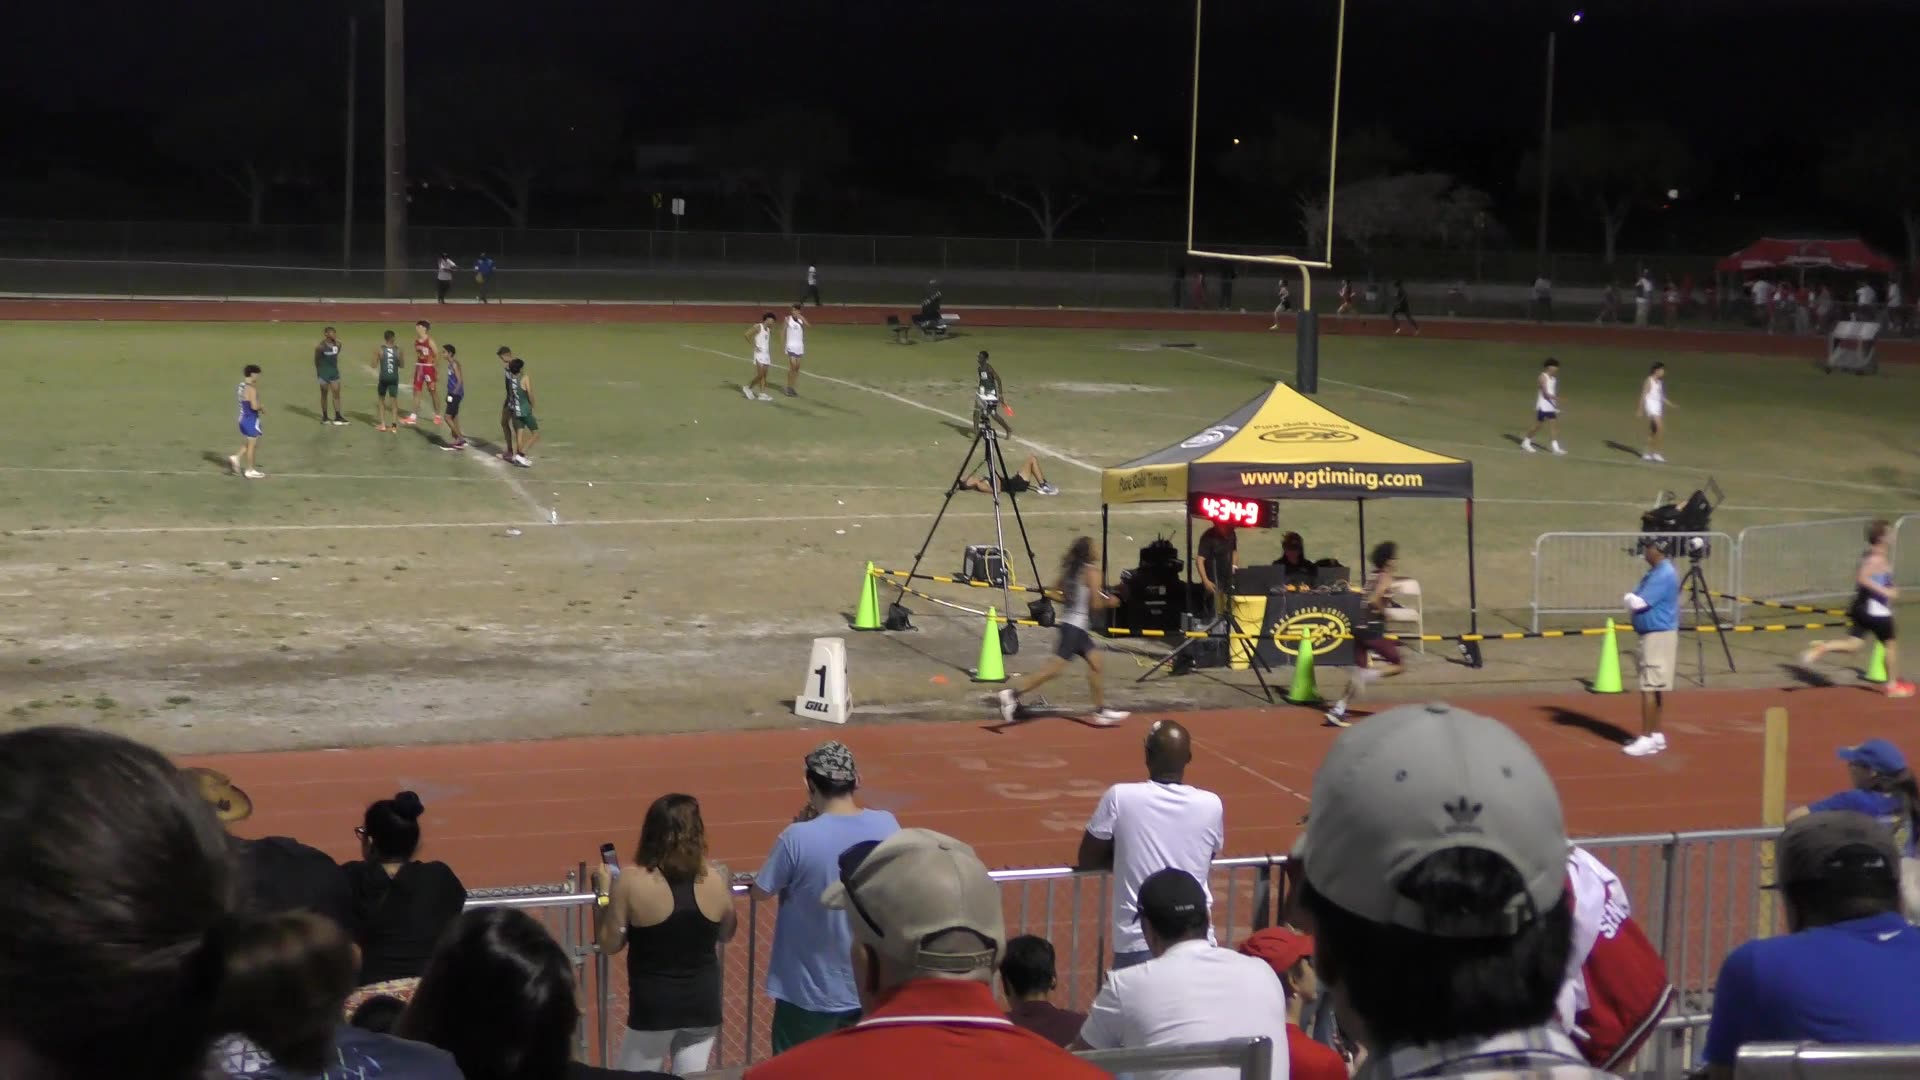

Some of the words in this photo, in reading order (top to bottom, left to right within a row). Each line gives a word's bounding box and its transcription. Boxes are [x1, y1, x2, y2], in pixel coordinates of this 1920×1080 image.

[1240, 466, 1423, 490] www.pgtiming.com
[814, 664, 827, 698] 1
[804, 700, 830, 713] GILL
